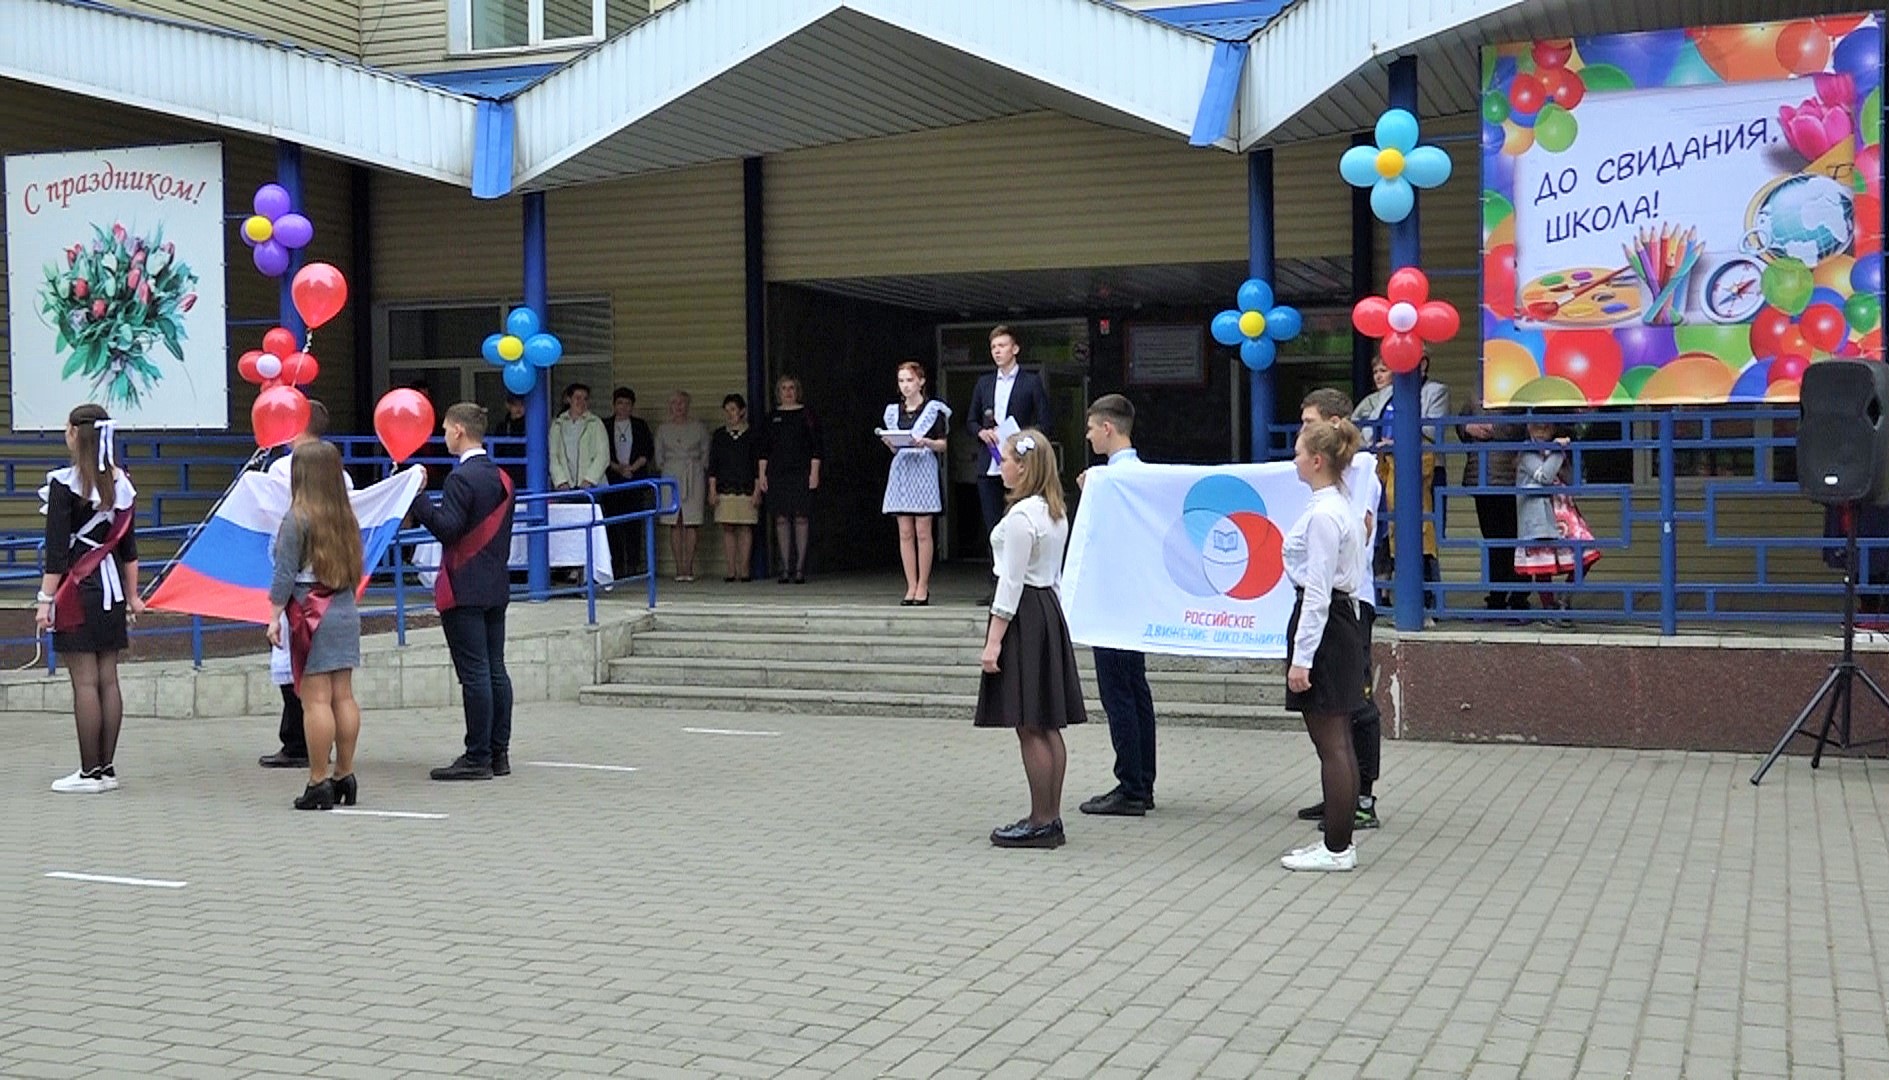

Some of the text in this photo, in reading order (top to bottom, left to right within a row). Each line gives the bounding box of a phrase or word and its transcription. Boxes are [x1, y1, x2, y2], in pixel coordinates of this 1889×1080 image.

[24, 160, 206, 215] С праздником!
[1535, 167, 1578, 206] ДО
[1546, 190, 1660, 243] ШКОЛА!
[1144, 623, 1208, 641] ДВИЖЕНИЕ
[1184, 609, 1256, 629] РОССИЙСКОЕ
